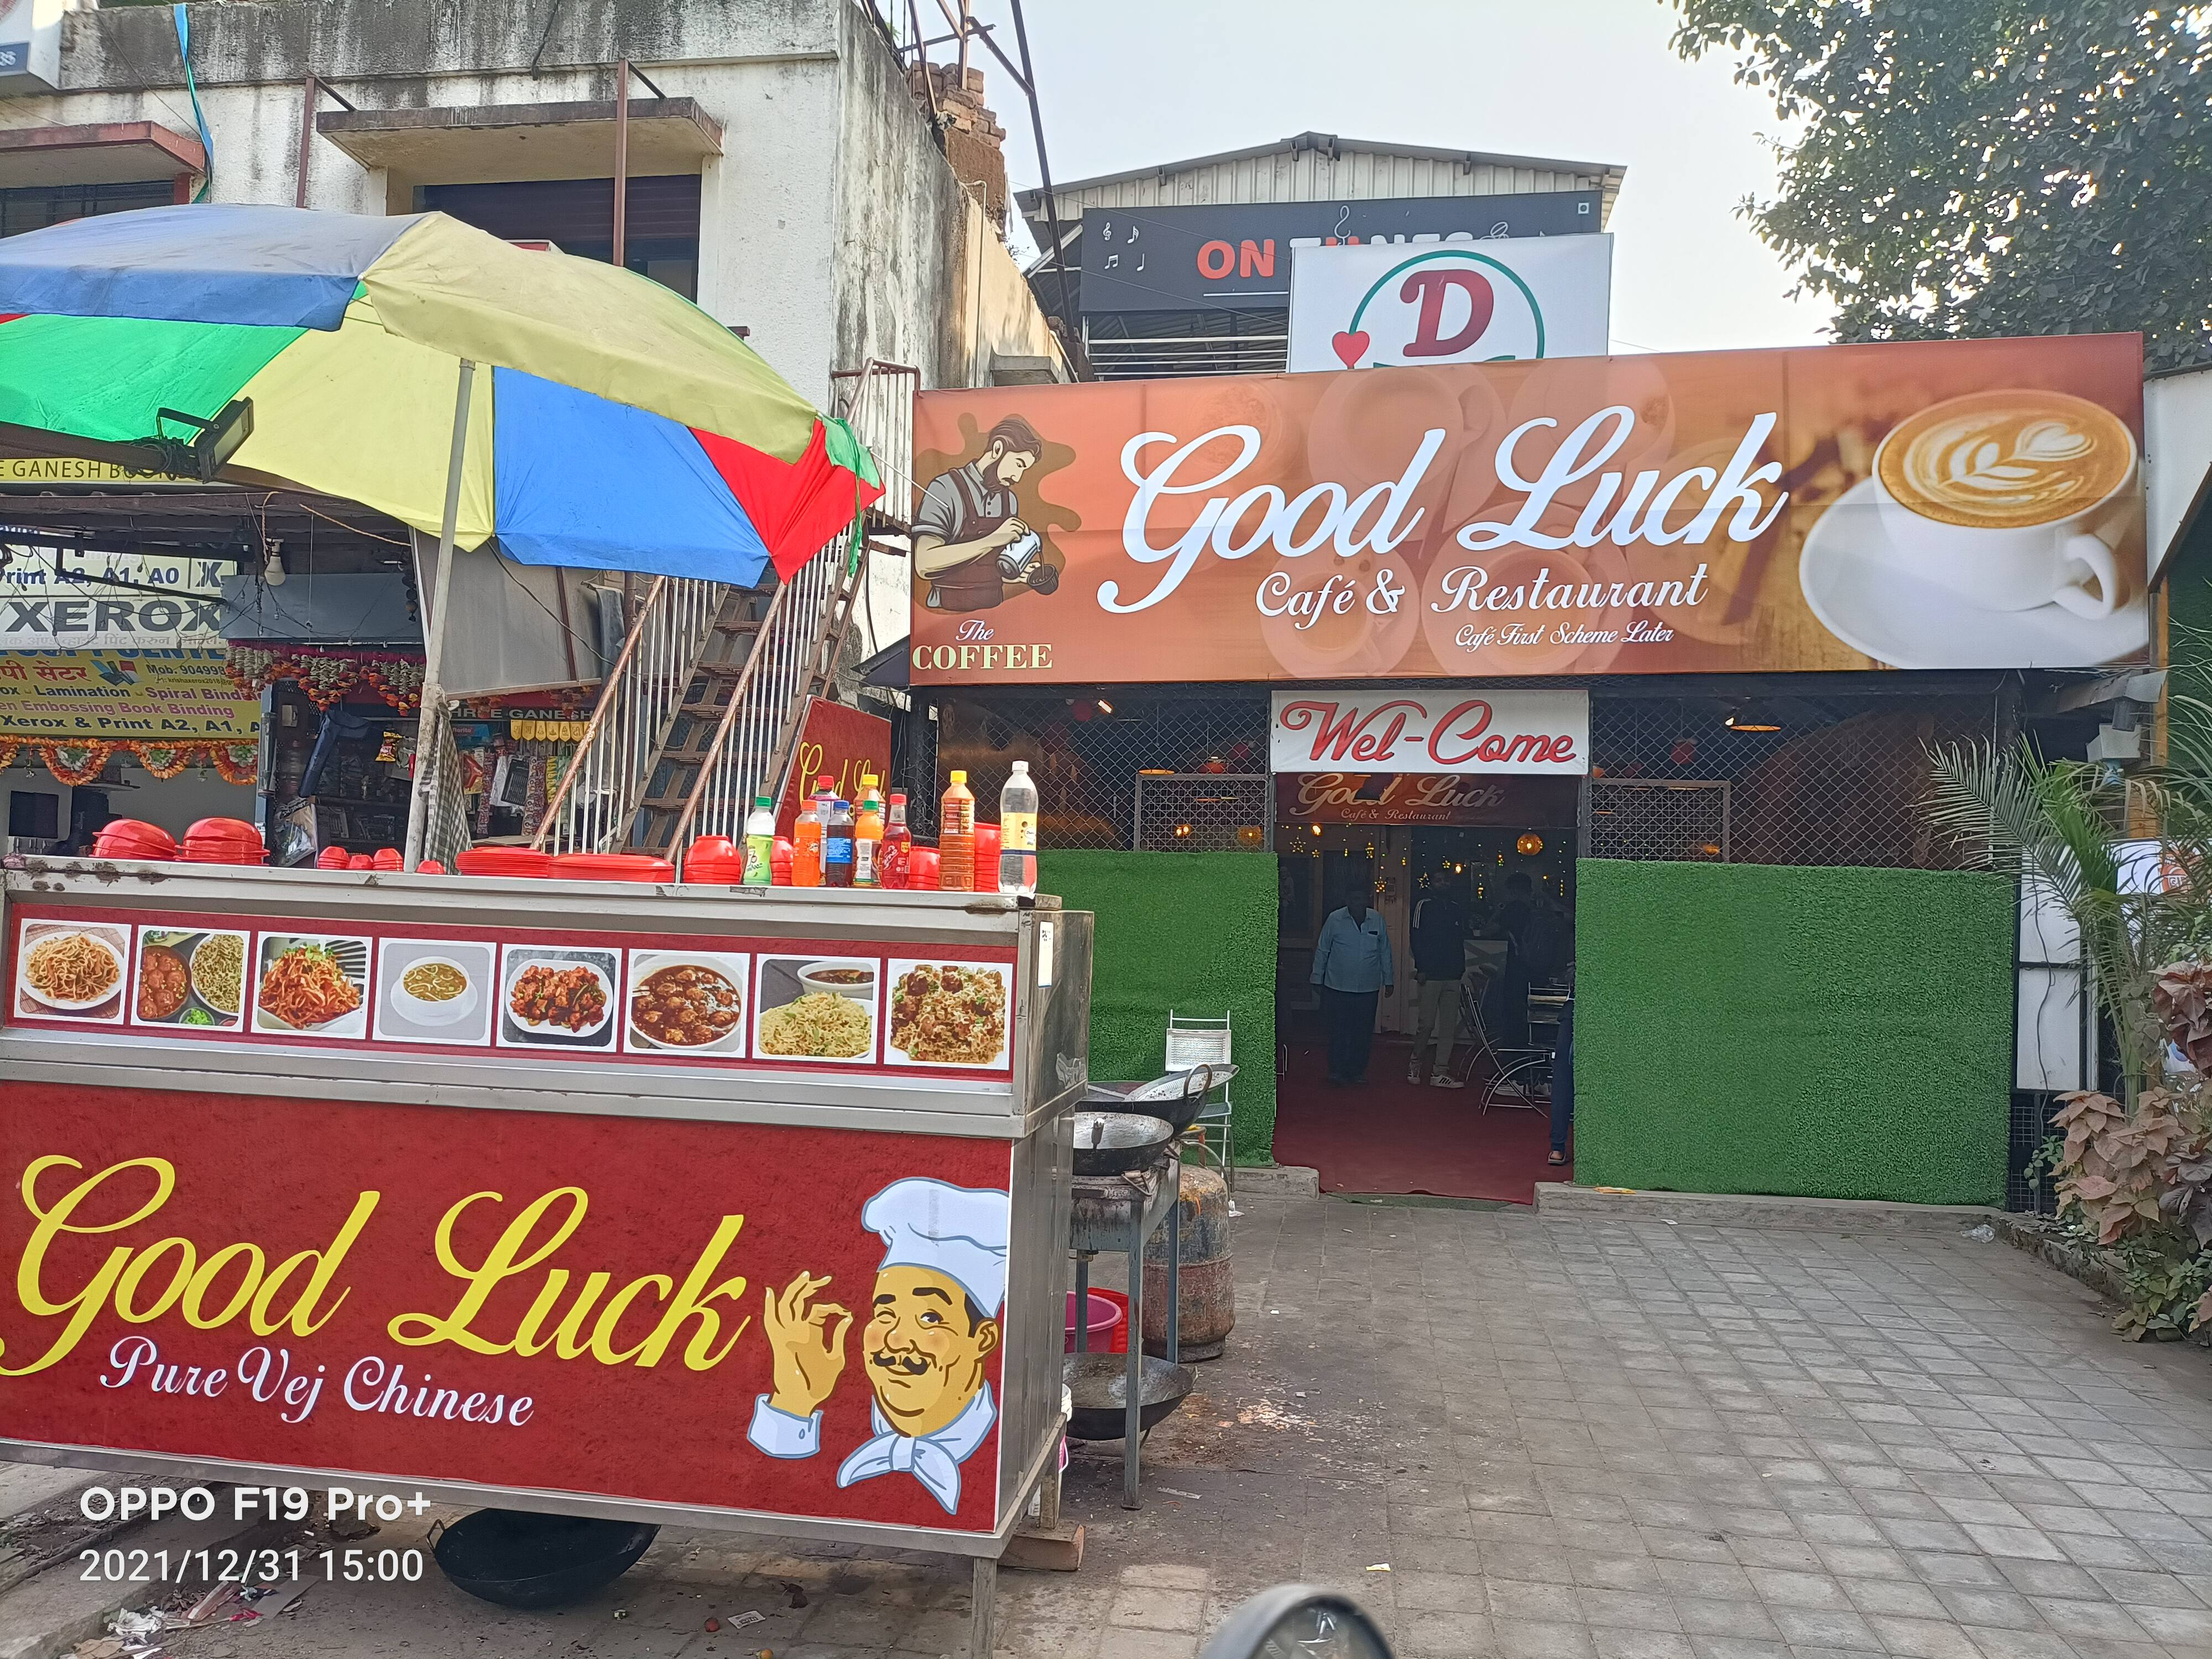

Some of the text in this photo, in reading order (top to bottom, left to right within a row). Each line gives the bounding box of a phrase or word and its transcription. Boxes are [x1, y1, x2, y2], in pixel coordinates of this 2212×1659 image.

[1196, 237, 1275, 279] ON
[1399, 268, 1494, 358] D
[12, 460, 101, 478] GANESH
[1097, 404, 1790, 614] Good Luck
[147, 567, 179, 585] A0
[1255, 563, 1709, 630] Café & Restaurant
[5, 600, 220, 632] XEROX
[956, 619, 995, 641] The
[1455, 618, 1674, 653] Café First Scheme Later
[912, 644, 1053, 670] COFFEE
[33, 685, 131, 697] Lamination
[145, 687, 198, 701] Spiral
[0, 714, 69, 728] Xerox
[75, 717, 92, 729] &
[97, 717, 154, 730] Print
[20, 700, 116, 716] Embossing
[118, 702, 165, 714] Book
[167, 703, 236, 719] Binding
[1405, 774, 1506, 809] Luck
[1384, 808, 1452, 821] Restaurant
[0, 1155, 751, 1376] Good Luck
[100, 1335, 534, 1427] Pure Vej Chinese
